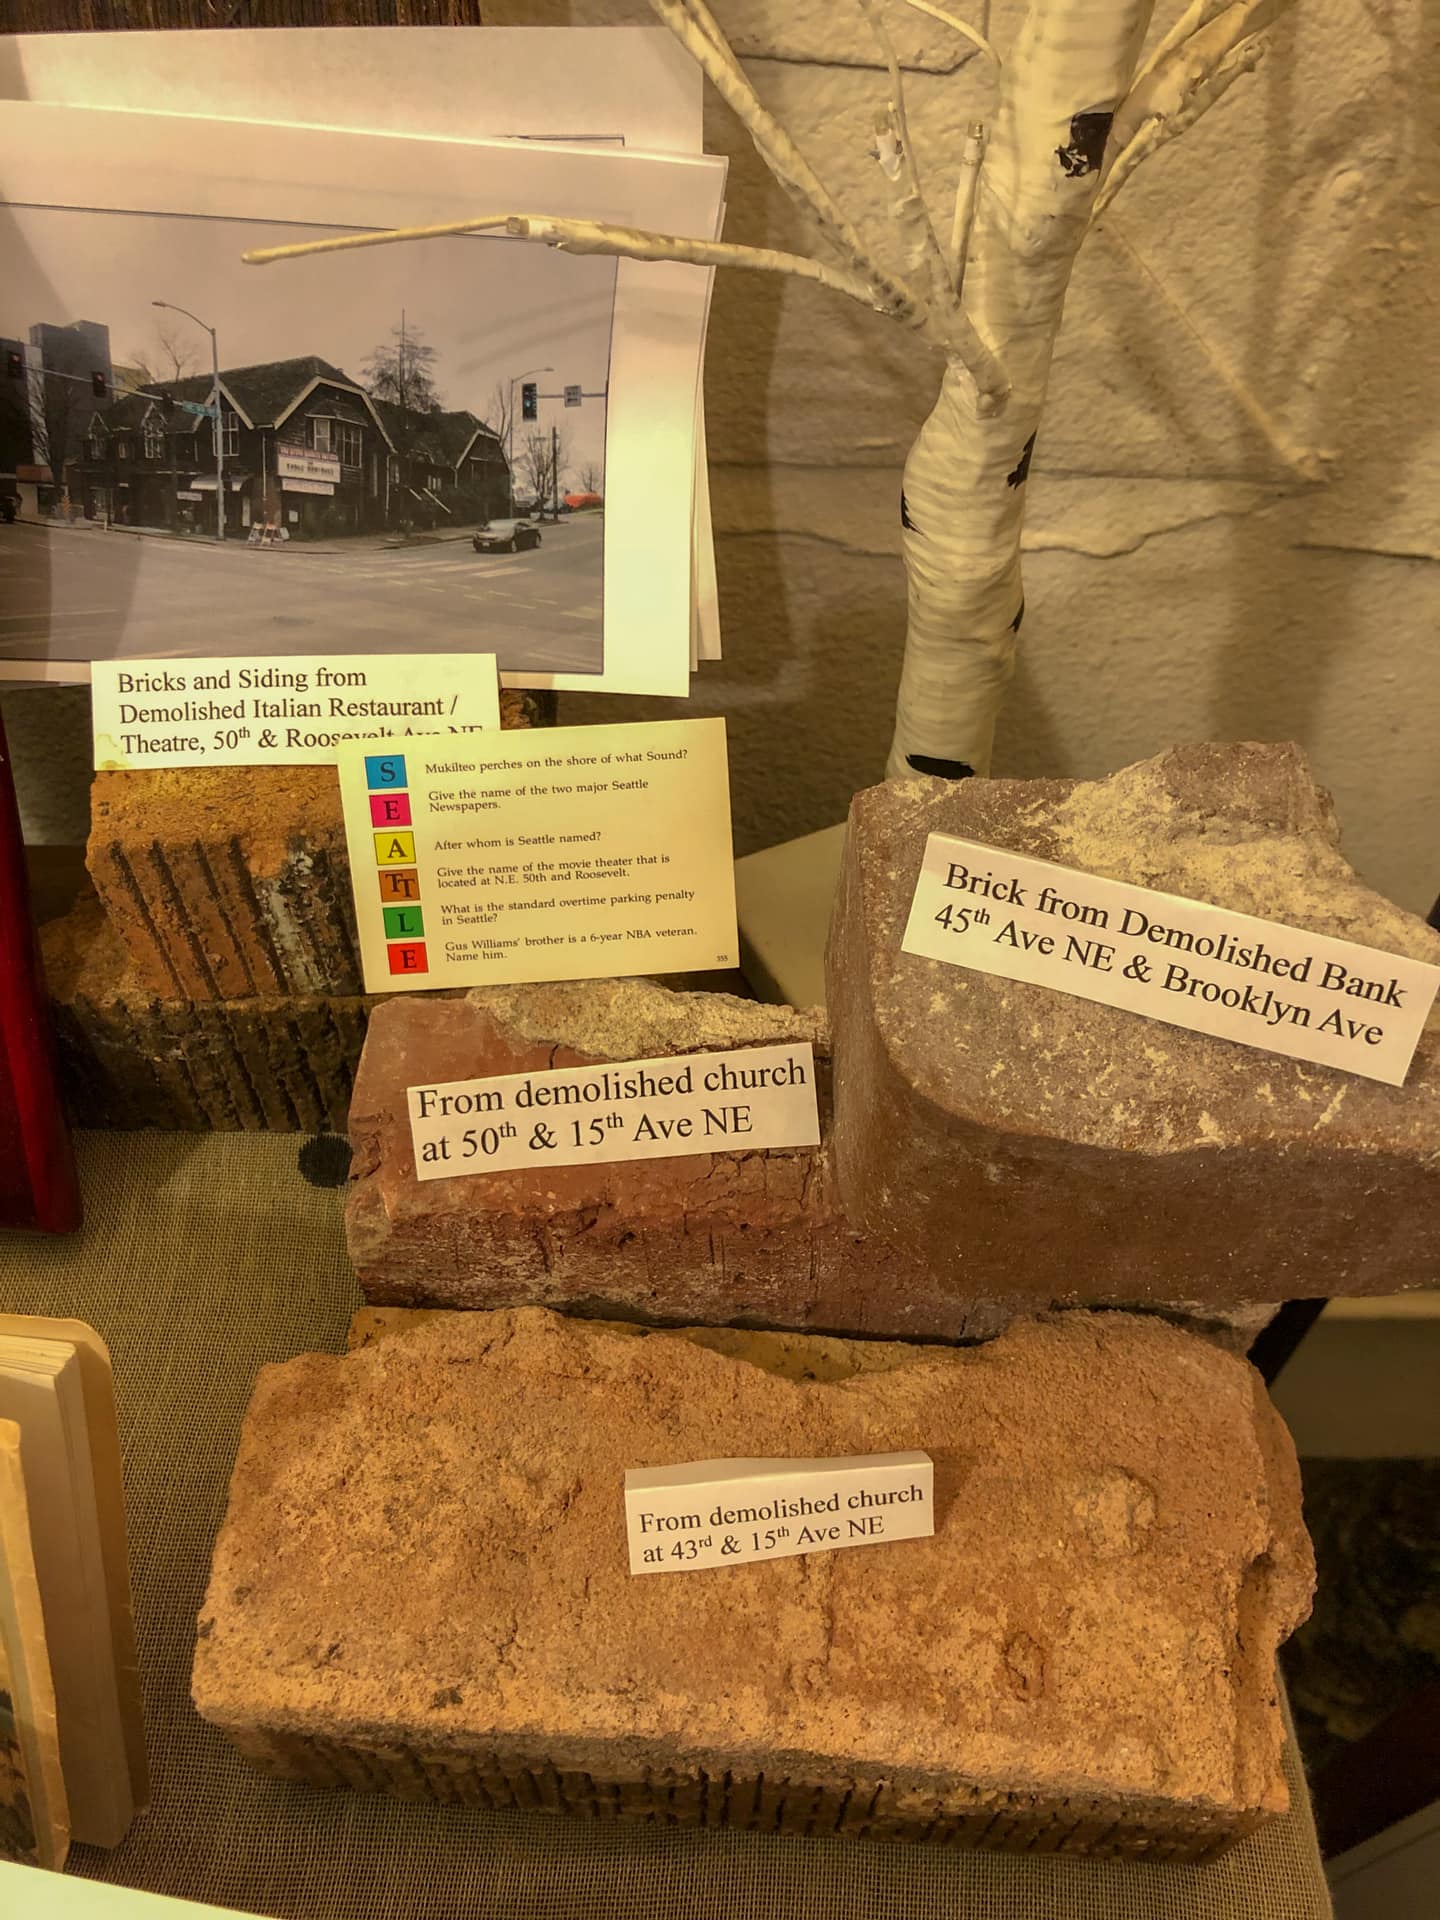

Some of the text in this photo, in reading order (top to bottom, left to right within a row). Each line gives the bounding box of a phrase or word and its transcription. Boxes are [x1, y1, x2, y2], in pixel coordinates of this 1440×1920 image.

[118, 667, 366, 693] Bricks and Siding from
[119, 695, 458, 724] Demolished Italian Restaurant /
[120, 734, 206, 755] Theatre,
[213, 727, 251, 750] 50th
[258, 728, 277, 748] &
[380, 761, 396, 782] S
[425, 749, 688, 774] Mukilteo perches on the shore of what Sound?
[428, 779, 649, 801] Give the name of the two major Seattle
[384, 800, 400, 821] E
[430, 802, 501, 813] Newspapers.
[387, 838, 408, 858] A
[434, 831, 601, 851] After whom is Seattle named?
[437, 854, 670, 878] Give the name of the movie theater that is
[438, 868, 630, 889] located at N.E. 50th and Roosevelt.
[441, 889, 695, 914] What is the standard overtime parking penalty
[397, 913, 414, 932] L
[442, 914, 498, 925] in Seattle?
[445, 941, 468, 952] Gus
[471, 938, 520, 950] Williams'
[525, 935, 564, 946] brother
[568, 934, 577, 944] is
[590, 932, 622, 944] 6-year
[626, 929, 652, 939] NBA
[655, 927, 697, 937] veteran.
[943, 862, 1408, 1009] Brick from Demolished Bank
[400, 949, 417, 969] E
[446, 950, 507, 962] Name him.
[934, 903, 1384, 1045] 45th Ave NE & Brooklyn Ave
[416, 1058, 806, 1119] From demolished church
[421, 1105, 753, 1162] at 50th & 15th Ave NE
[639, 1484, 923, 1533] From demolished church
[643, 1516, 885, 1563] at 43rd & 15th Ave NE
